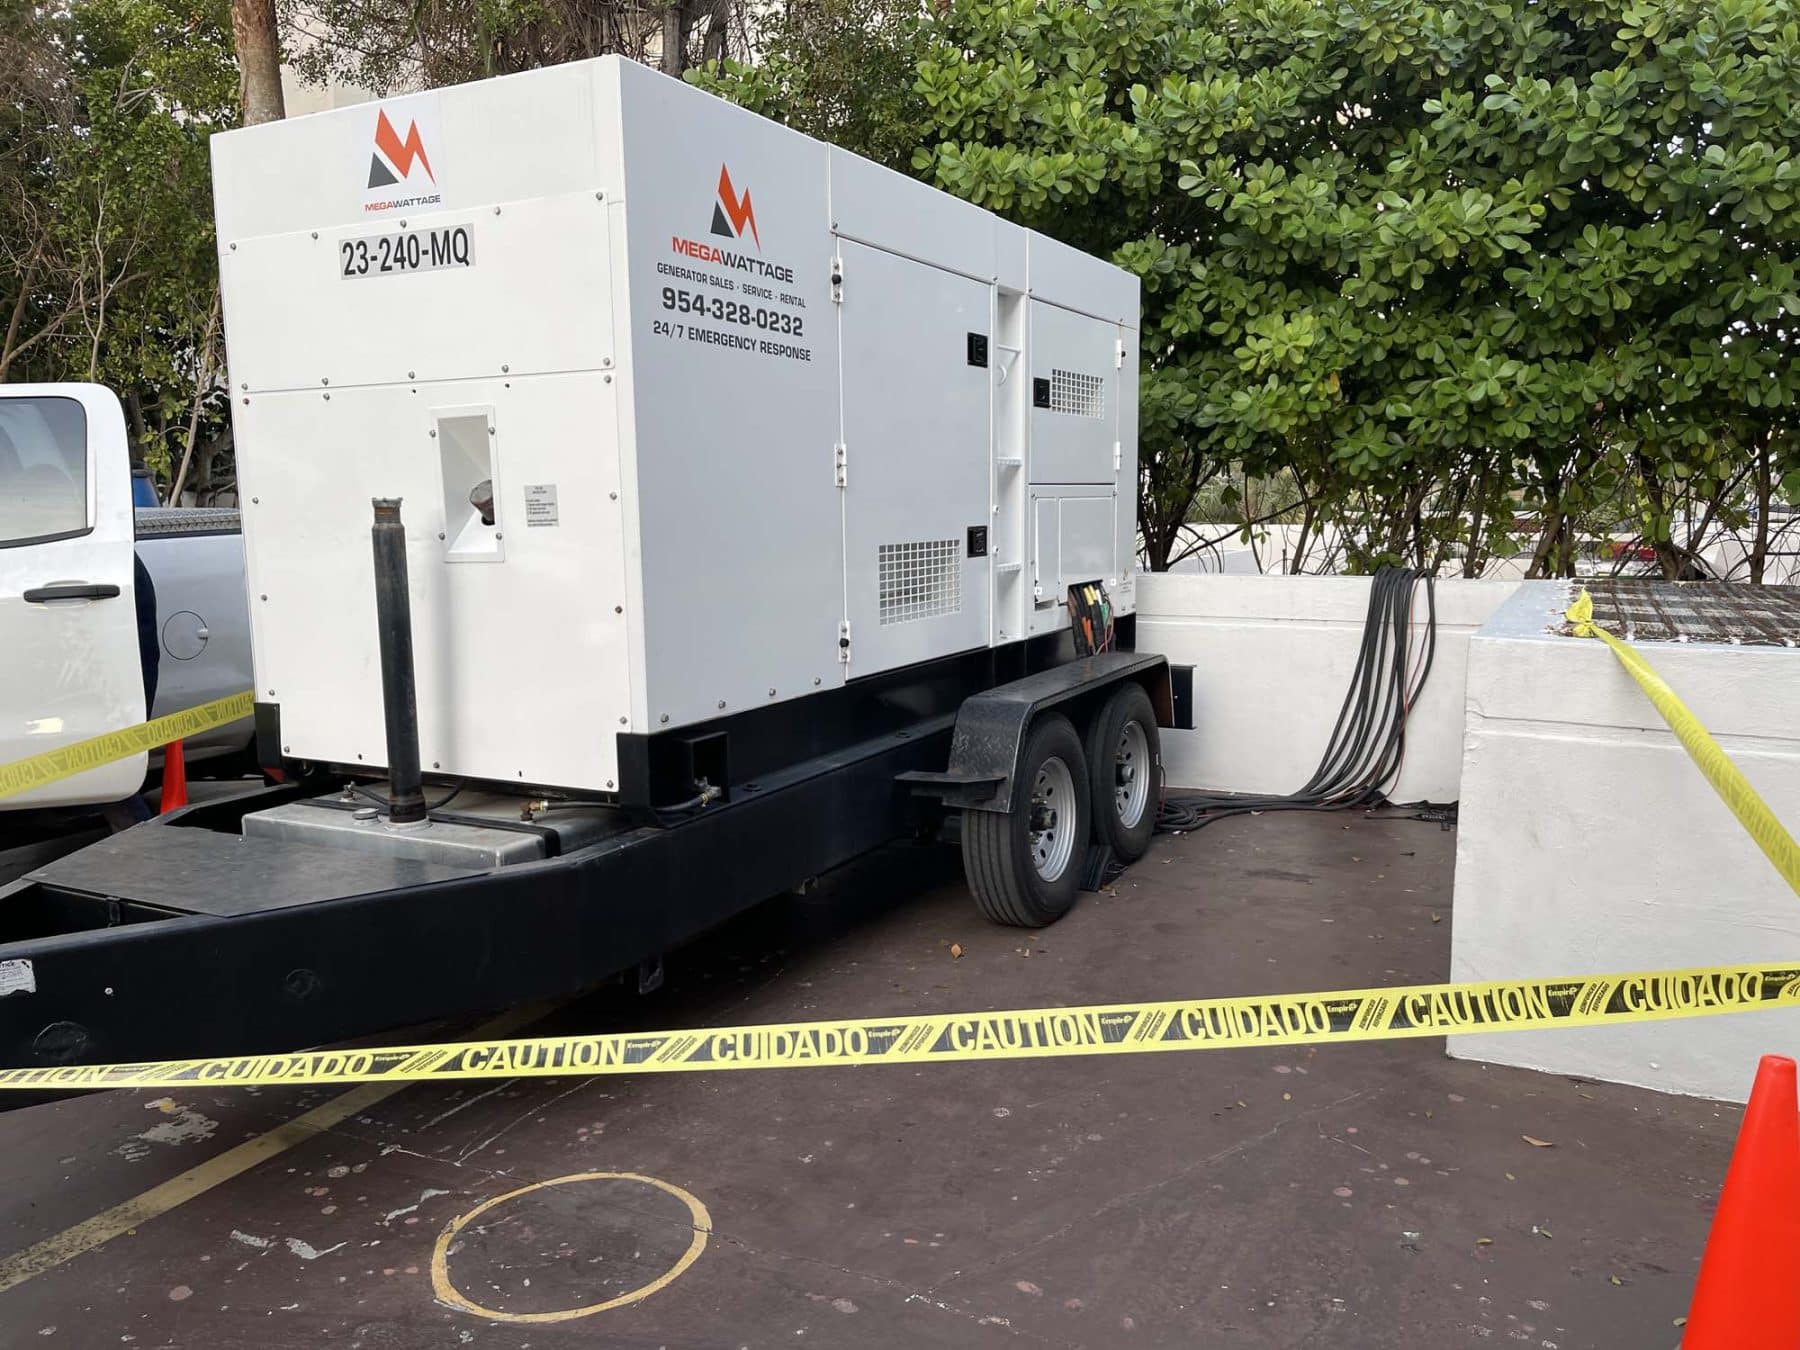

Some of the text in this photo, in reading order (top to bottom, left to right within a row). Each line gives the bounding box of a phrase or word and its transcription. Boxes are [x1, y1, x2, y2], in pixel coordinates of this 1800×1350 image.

[364, 195, 441, 212] MEGAWATTAGE
[342, 228, 470, 276] 23-240-MQ
[672, 236, 794, 283] MEGAWATTAGE
[657, 262, 806, 308] GENERATOR SALES SERVICE RENTAL
[653, 320, 811, 361] 24/7 EMERGENCY RESPONSE
[1405, 984, 1554, 1028] CAUTION
[1623, 972, 1764, 1012] CUIDADO
[951, 1013, 1104, 1051] CAUTION
[1181, 1001, 1331, 1040] CUIDADO
[461, 1039, 627, 1071] CAUTION
[711, 1027, 869, 1062] CUIDADO
[0, 1066, 113, 1083] UTION
[197, 1054, 374, 1081] CUIDADO
